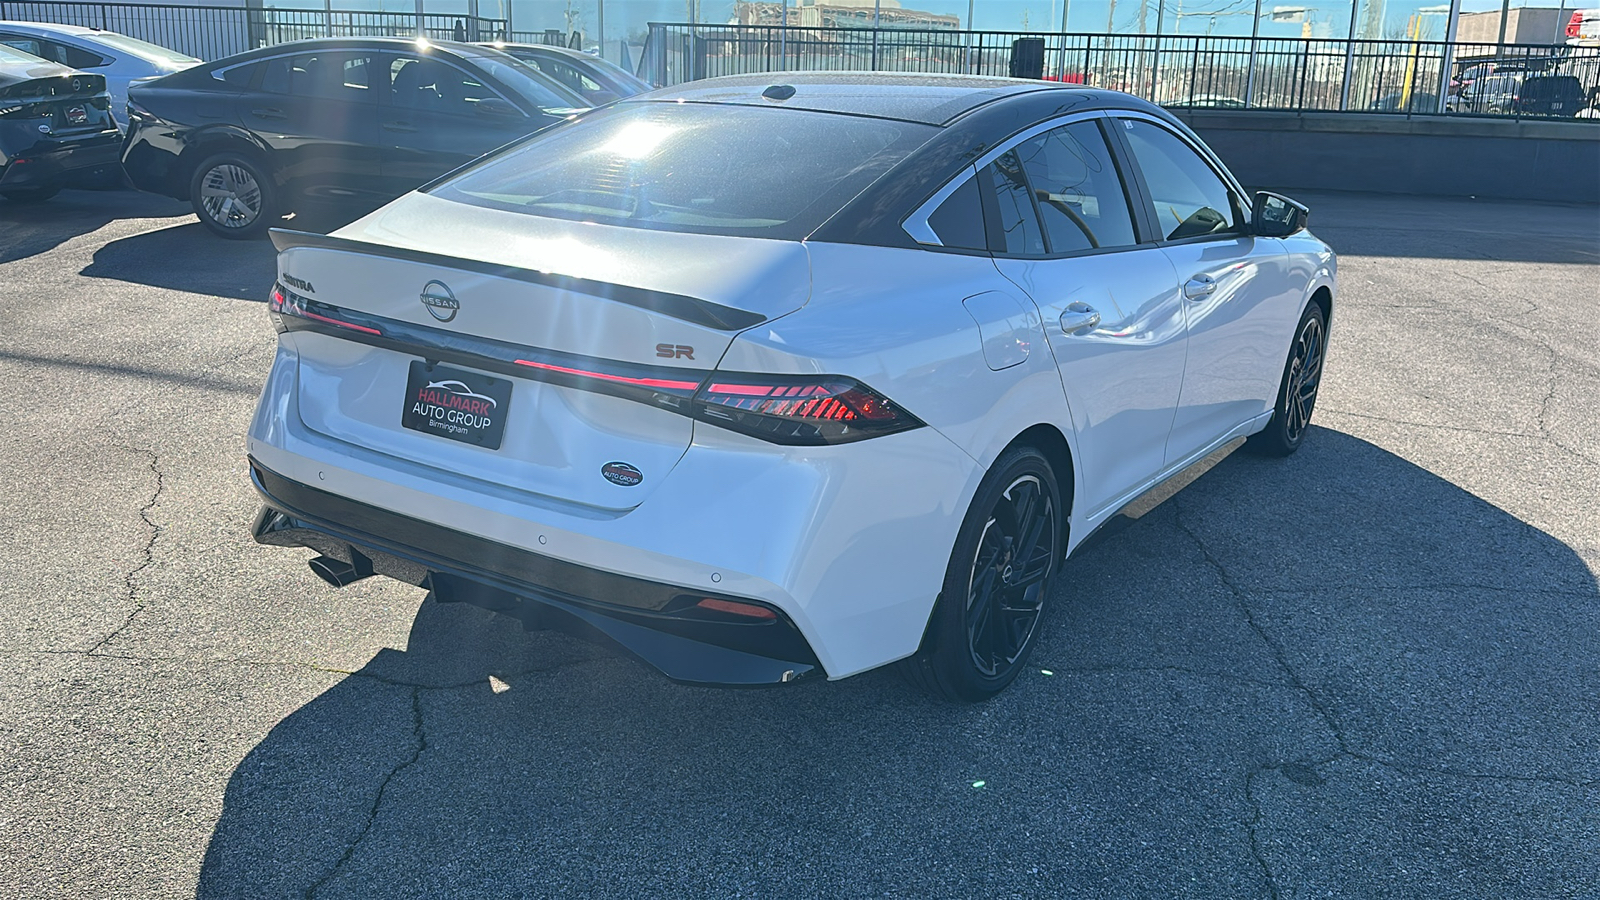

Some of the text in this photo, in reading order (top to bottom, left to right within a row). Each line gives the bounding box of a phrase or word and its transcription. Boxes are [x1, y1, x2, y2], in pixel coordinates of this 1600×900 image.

[420, 295, 457, 309] NISSAN
[656, 343, 695, 360] SR
[418, 388, 490, 416] HALLMARK
[412, 402, 491, 430] AUTO GROUP
[429, 419, 468, 435] Birmingham
[604, 471, 619, 479] AUTO
[620, 475, 639, 484] GROUP
